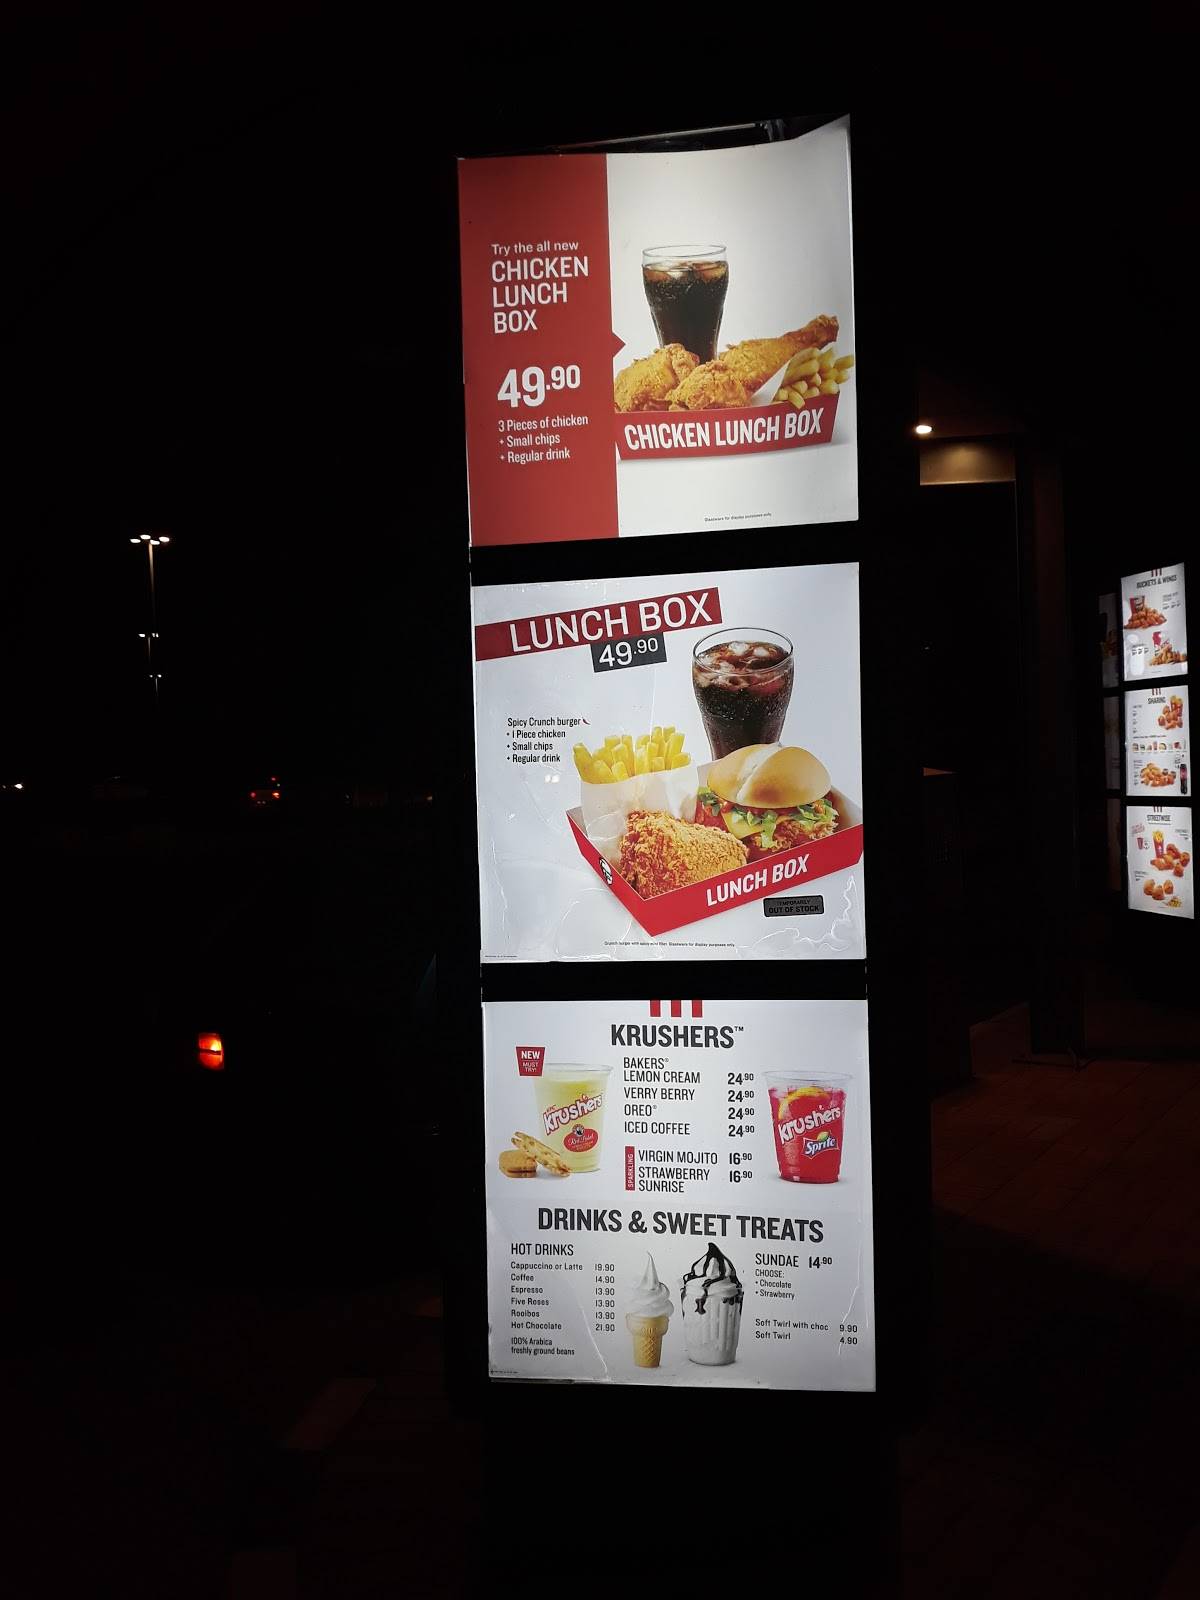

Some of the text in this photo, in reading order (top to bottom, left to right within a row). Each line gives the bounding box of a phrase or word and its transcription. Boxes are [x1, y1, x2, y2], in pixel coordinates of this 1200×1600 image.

[491, 240, 579, 256] Try the all new
[491, 256, 589, 283] CHICKEN
[492, 282, 568, 308] LUNCH
[493, 309, 538, 334] BOX
[497, 364, 581, 408] 49.90
[498, 414, 589, 433] 3 Pieces of chicken
[624, 407, 824, 450] CHICKEN LUNCH BOX
[506, 433, 561, 448] Small chips
[507, 447, 571, 465] Regular drink
[509, 592, 713, 653] LUNCH BOX
[599, 637, 660, 667] 49.90
[507, 717, 581, 728] Spicy Crunch burger
[516, 729, 536, 739] Piece
[537, 729, 566, 739] chicken
[512, 741, 554, 752] Small chips
[512, 753, 561, 764] Regular drink
[706, 853, 810, 907] LUNCH BOX
[795, 904, 820, 913] STOCK
[521, 1051, 541, 1060] NEW
[623, 1070, 701, 1084] LEMON CREAM
[727, 1072, 754, 1086] 24.90
[623, 1087, 695, 1101] VERRY BERRY
[727, 1090, 755, 1103] 24.90
[728, 1107, 755, 1120] 24.90
[624, 1121, 691, 1135] ICED COFFEE
[728, 1124, 755, 1138] 24.90
[804, 1136, 836, 1156] Sprite
[638, 1150, 718, 1165] VIRGIN MOJITO
[729, 1152, 753, 1165] 16.90
[638, 1166, 710, 1181] STRAWBERRY
[729, 1170, 753, 1183] 16.90
[638, 1180, 685, 1193] SUNRISE
[538, 1207, 825, 1243] DRINKS & SWEET TREATS
[511, 1243, 574, 1256] HOT DRINKS
[510, 1261, 583, 1271] Cappuccino or Latte
[594, 1263, 615, 1272] 19.90
[755, 1253, 833, 1269] SUNDAE 14.90
[510, 1273, 534, 1281] Coffee
[595, 1275, 615, 1284] 14.90
[510, 1285, 544, 1295] Espresso
[759, 1279, 792, 1289] Chocolate
[595, 1287, 615, 1296] 13.90
[759, 1288, 795, 1301] Strawberry
[511, 1297, 549, 1306] Five Roses
[595, 1299, 615, 1308] 13.90
[511, 1309, 540, 1318] Rooibos
[595, 1311, 615, 1320] 13.90
[511, 1321, 562, 1330] Hot Chocolate
[595, 1323, 615, 1332] 21.90
[755, 1318, 829, 1331] Soft Twirl with choc
[839, 1324, 858, 1333] 9.90
[511, 1337, 553, 1346] 100% Arabica
[755, 1330, 791, 1340] Soft Twirl
[839, 1336, 858, 1345] 4.90
[511, 1346, 575, 1356] freshly ground beans
